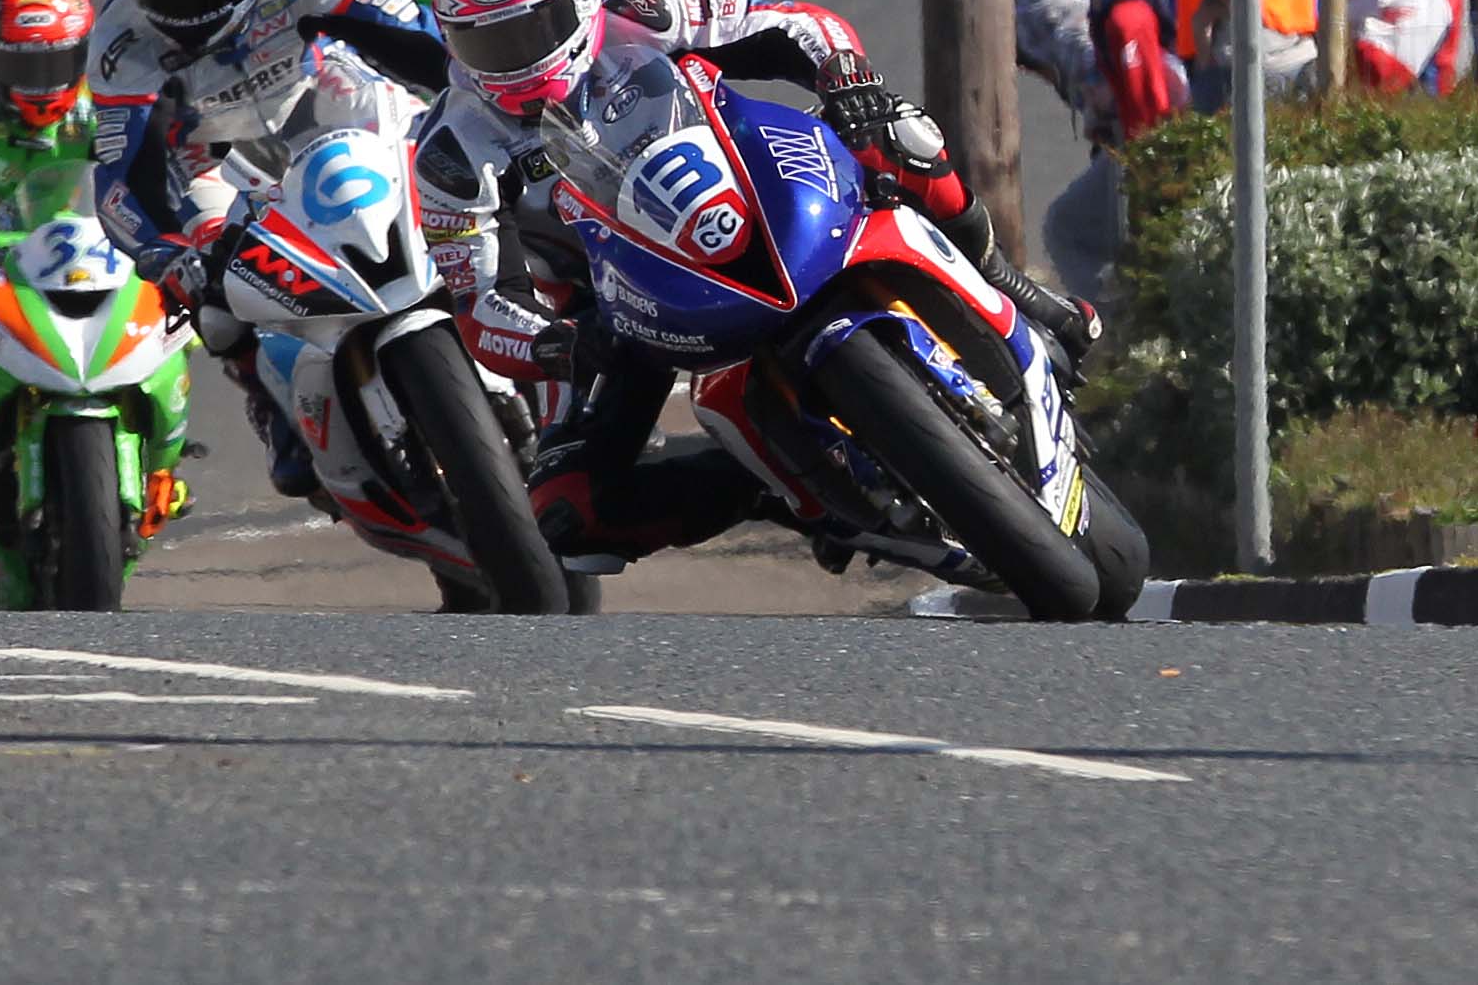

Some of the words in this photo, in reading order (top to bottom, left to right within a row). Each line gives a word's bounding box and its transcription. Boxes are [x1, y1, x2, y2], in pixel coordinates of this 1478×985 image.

[302, 141, 390, 226] 6
[633, 141, 724, 234] 13
[230, 258, 310, 317] Commercial
[434, 252, 466, 264] HEL
[631, 319, 659, 340] EAST
[661, 331, 706, 345] COAST
